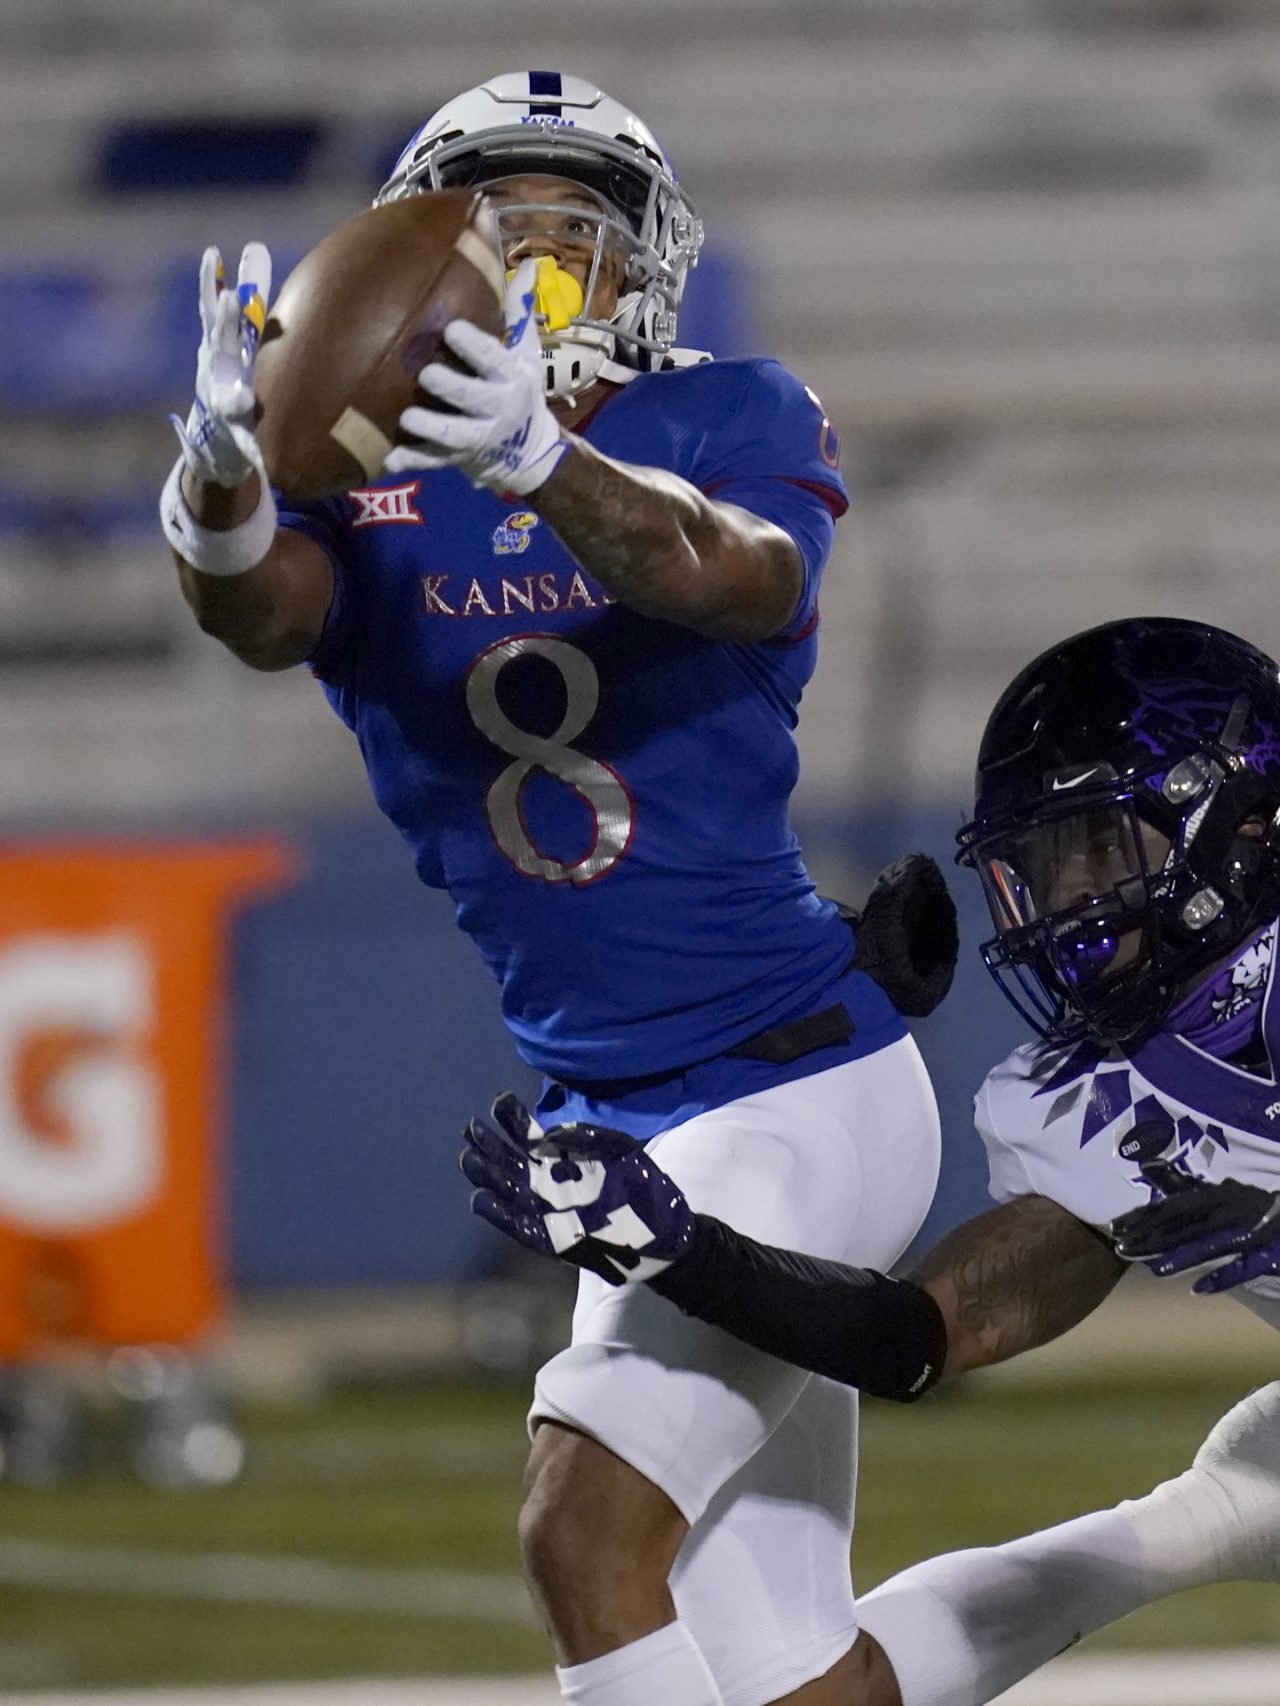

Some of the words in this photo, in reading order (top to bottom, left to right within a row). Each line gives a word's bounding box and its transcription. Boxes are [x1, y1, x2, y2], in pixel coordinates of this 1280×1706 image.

[349, 484, 419, 527] XII
[421, 569, 617, 616] KANSA
[466, 632, 637, 887] 8
[0, 932, 166, 1235] G
[1121, 1140, 1141, 1157] END
